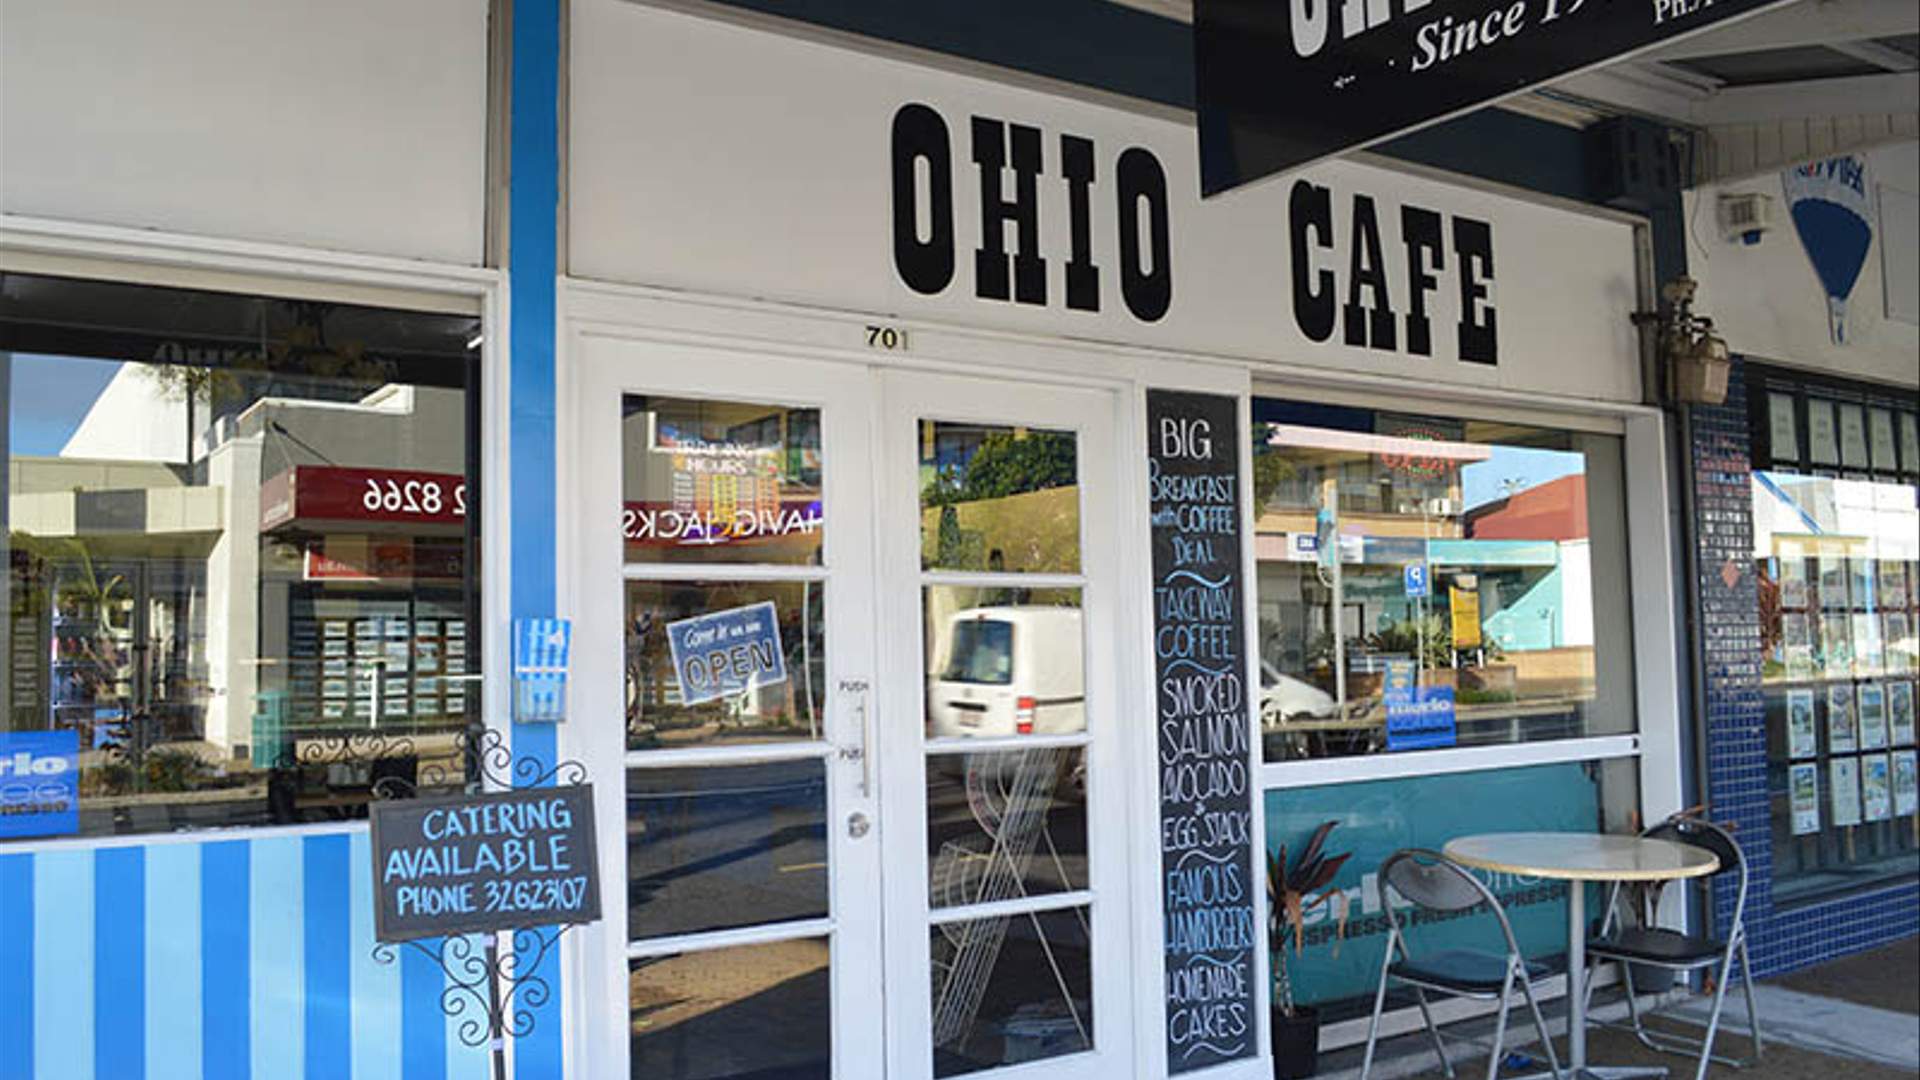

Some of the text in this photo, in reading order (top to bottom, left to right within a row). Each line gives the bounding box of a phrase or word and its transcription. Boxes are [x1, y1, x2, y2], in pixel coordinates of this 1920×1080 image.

[1411, 1, 1525, 72] Since
[891, 102, 1498, 366] OHIO CAFE
[866, 325, 909, 352] 701
[1160, 417, 1213, 460] BIG
[1150, 457, 1235, 503] BREAKFAST
[1176, 503, 1236, 536] COFFEE
[1172, 536, 1217, 566] DEAL
[1158, 623, 1236, 659] COFFEE
[683, 637, 774, 692] OPEN
[1162, 673, 1241, 718] SMOKED
[1161, 714, 1248, 765] SALMON
[1163, 759, 1246, 803] AVOCADO
[422, 799, 573, 841] CATERING
[1163, 811, 1250, 851] EGG STACK
[383, 834, 572, 884] AVAILABLE
[397, 882, 478, 917] PHONE
[1168, 862, 1243, 909] FAMOUS
[1165, 964, 1249, 1005] HOMEMADE
[1170, 1002, 1246, 1045] CAKES
